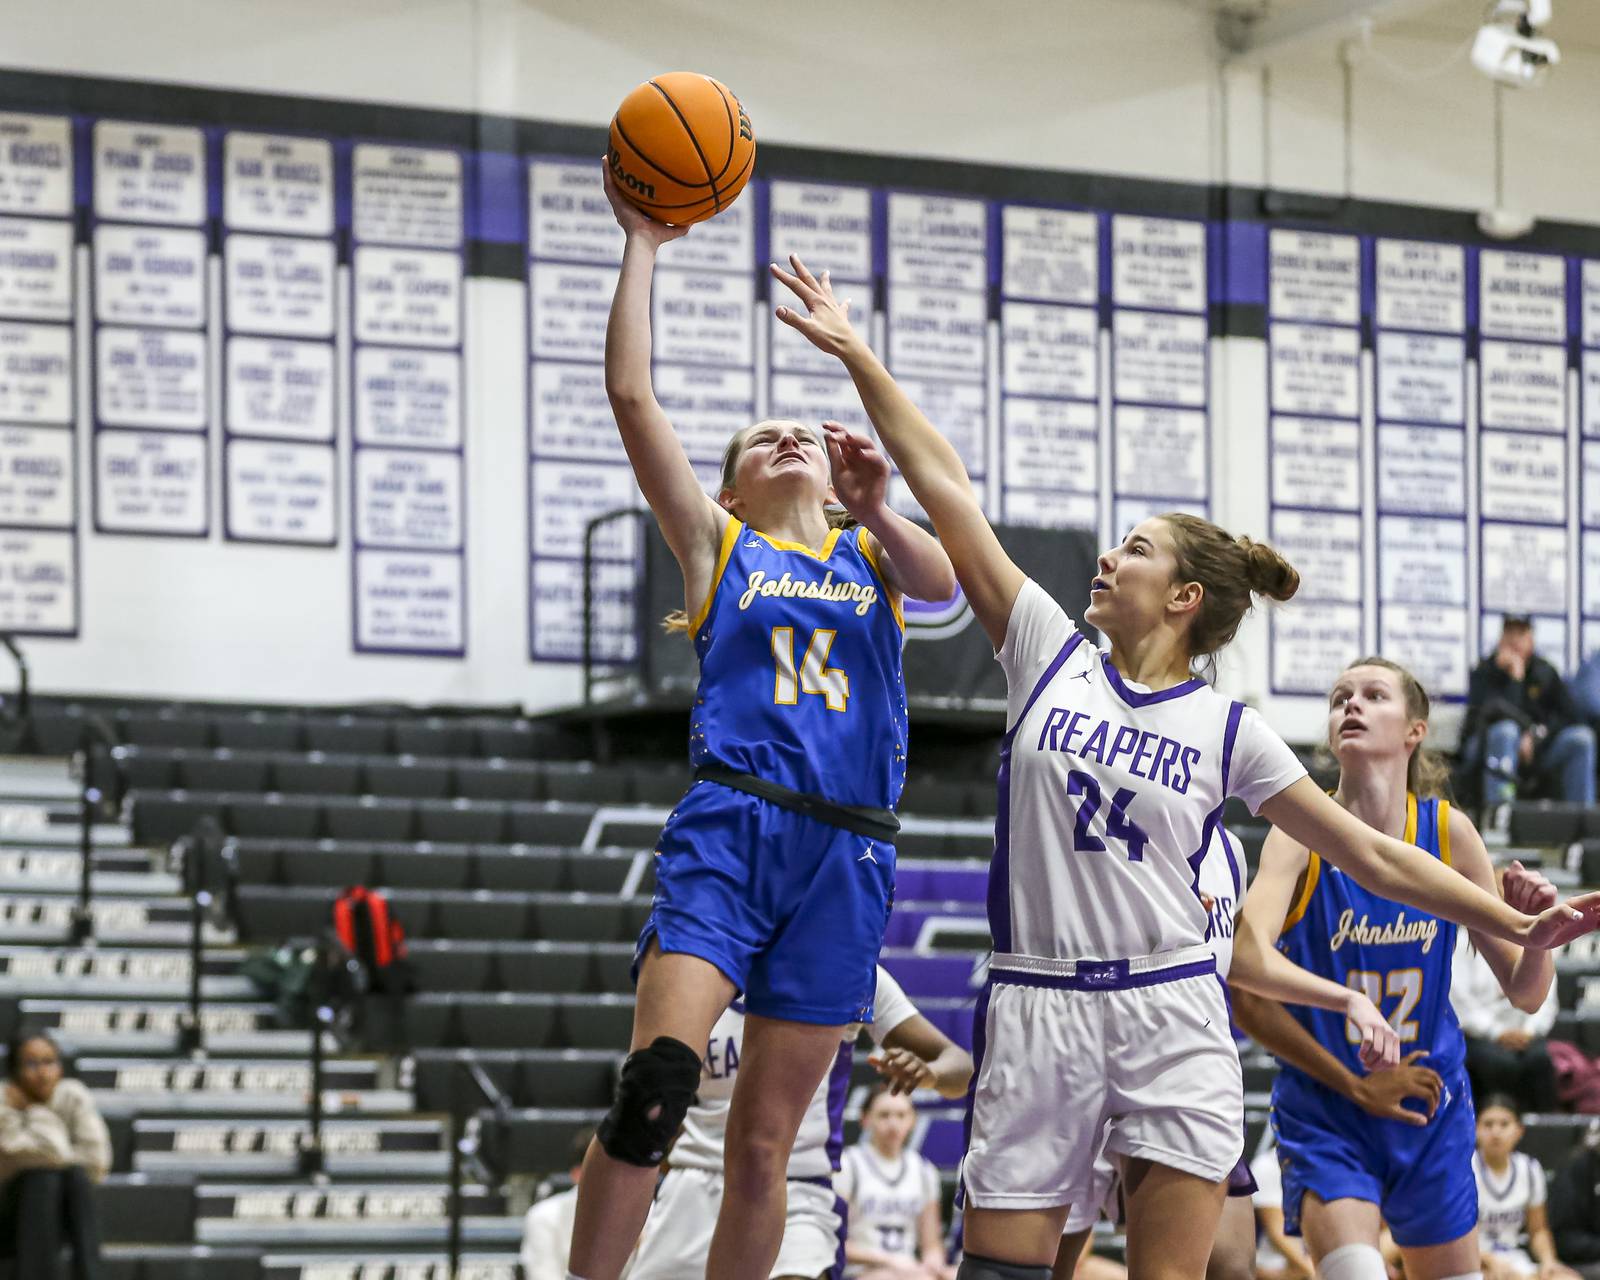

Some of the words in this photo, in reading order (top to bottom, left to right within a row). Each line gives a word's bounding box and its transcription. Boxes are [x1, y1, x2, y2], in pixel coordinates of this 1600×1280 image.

[738, 570, 878, 616] Johnsburg
[770, 626, 850, 713] 14
[1038, 707, 1202, 796] REAPERS
[1066, 769, 1149, 863] 24
[1330, 907, 1438, 955] Johnsburg
